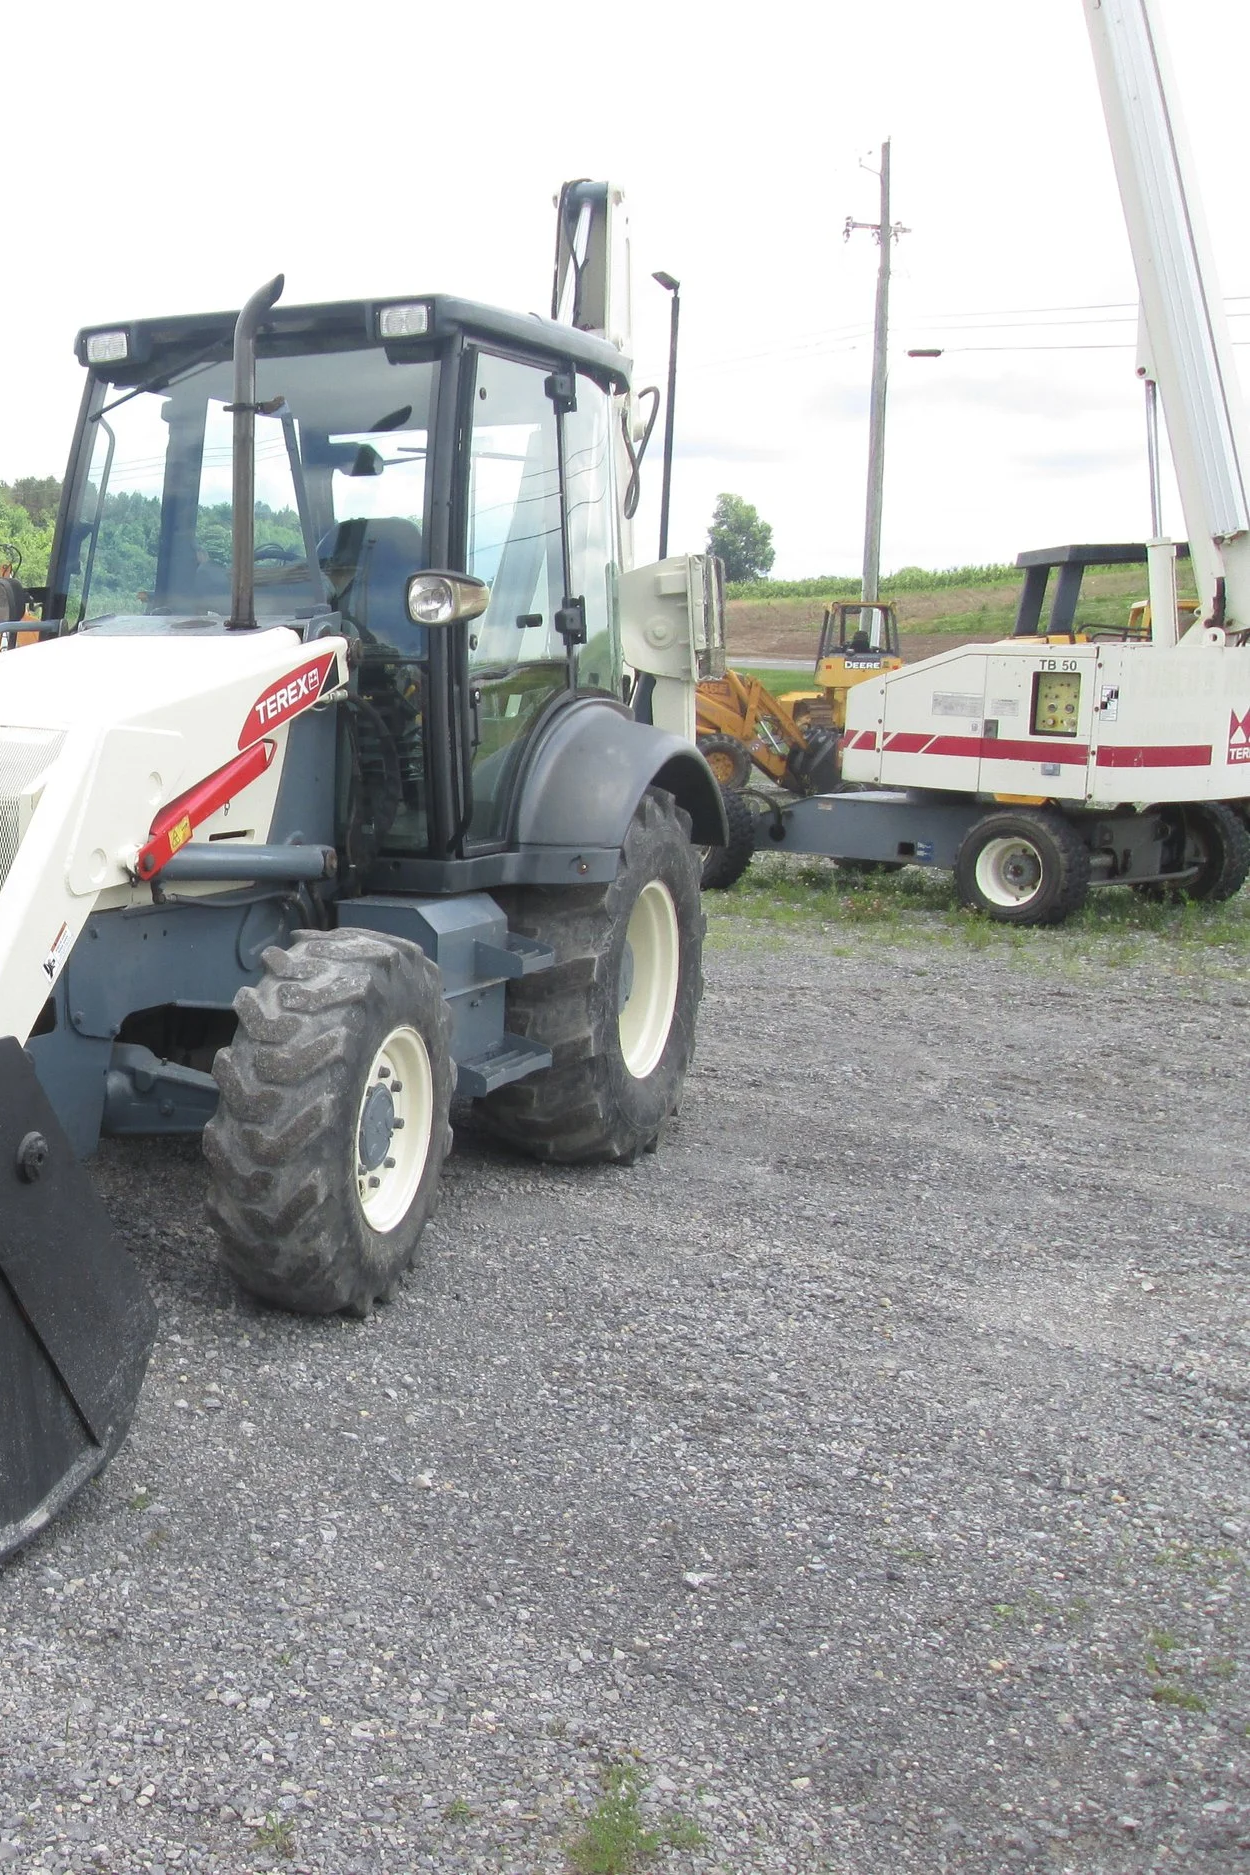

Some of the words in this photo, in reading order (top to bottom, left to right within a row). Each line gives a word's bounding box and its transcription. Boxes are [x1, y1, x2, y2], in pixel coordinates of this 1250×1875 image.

[844, 660, 880, 669] DEERE
[1039, 659, 1057, 671] TB
[1061, 660, 1077, 671] 50
[255, 673, 309, 725] TEREX
